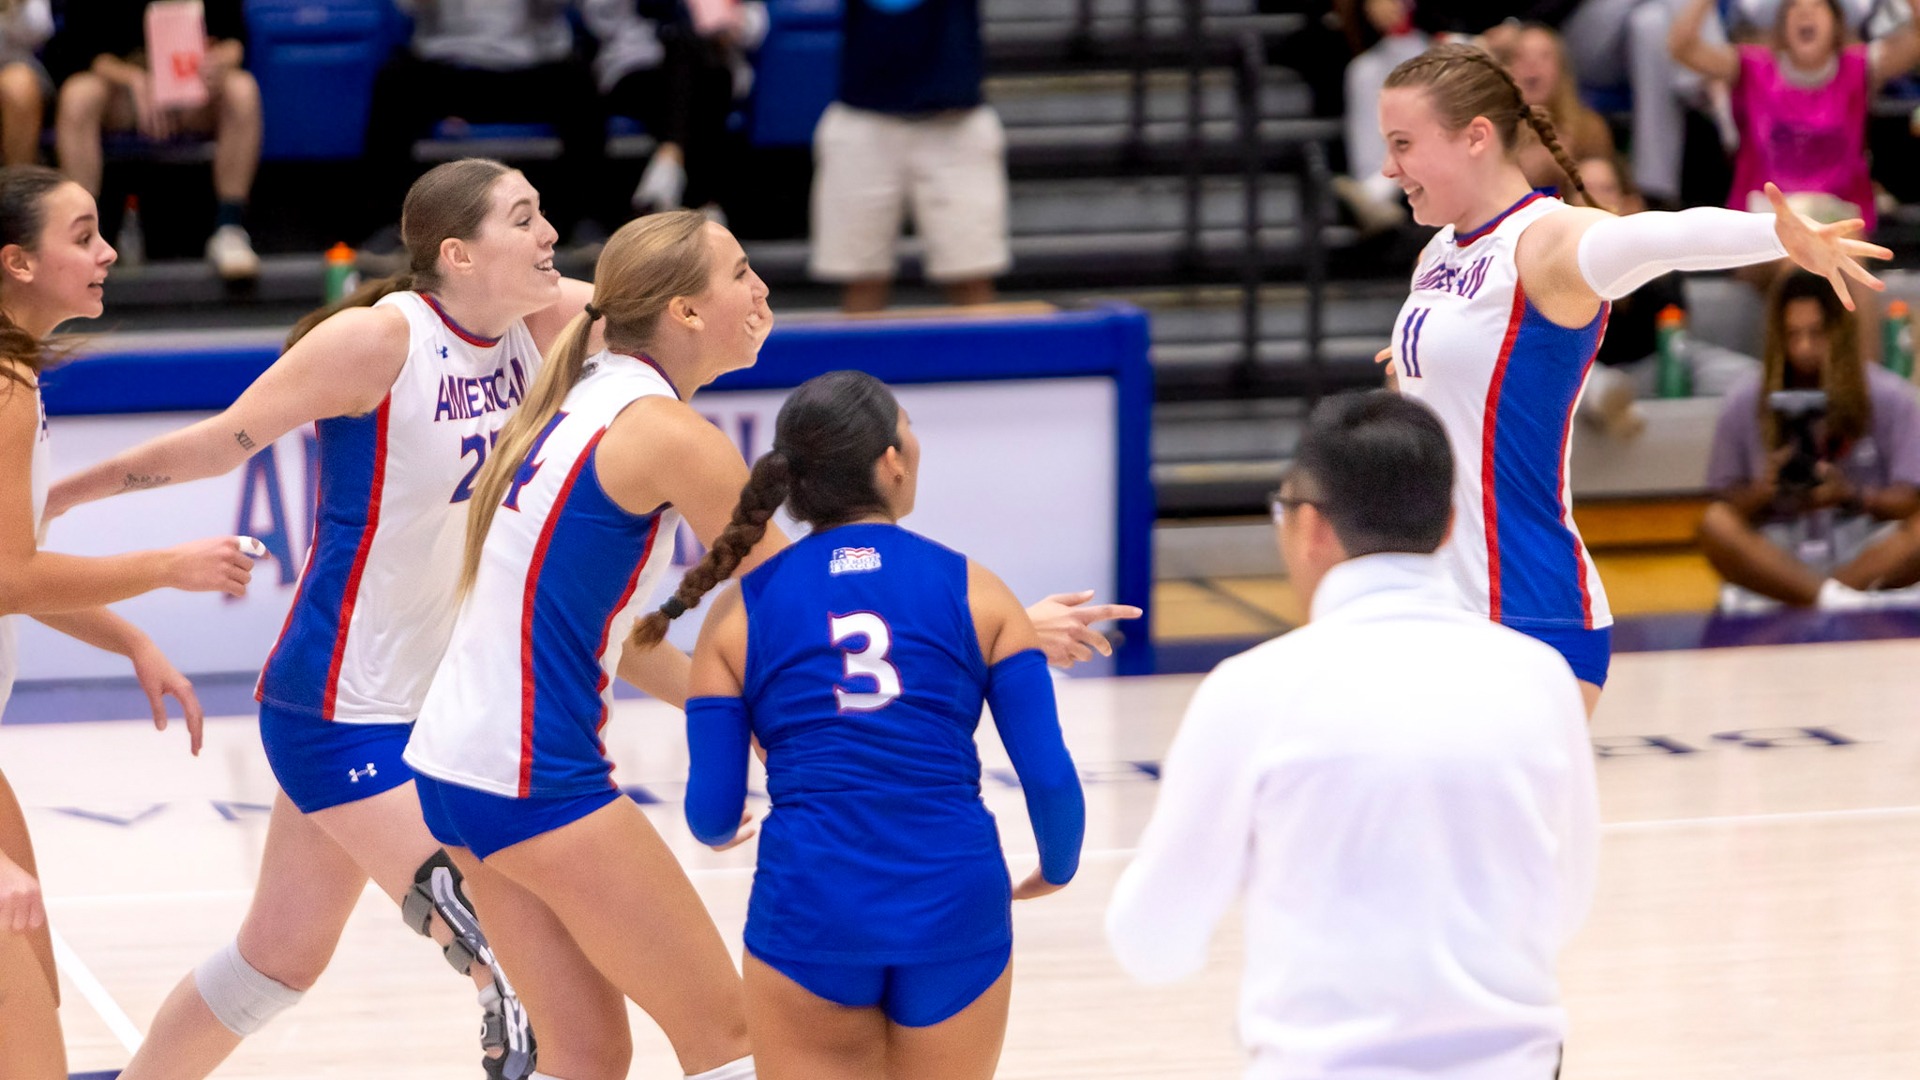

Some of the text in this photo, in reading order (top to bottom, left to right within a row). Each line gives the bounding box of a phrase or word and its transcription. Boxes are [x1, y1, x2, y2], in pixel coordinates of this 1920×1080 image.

[1401, 307, 1431, 378] 11
[449, 427, 500, 503] 2
[827, 610, 904, 715] 3
